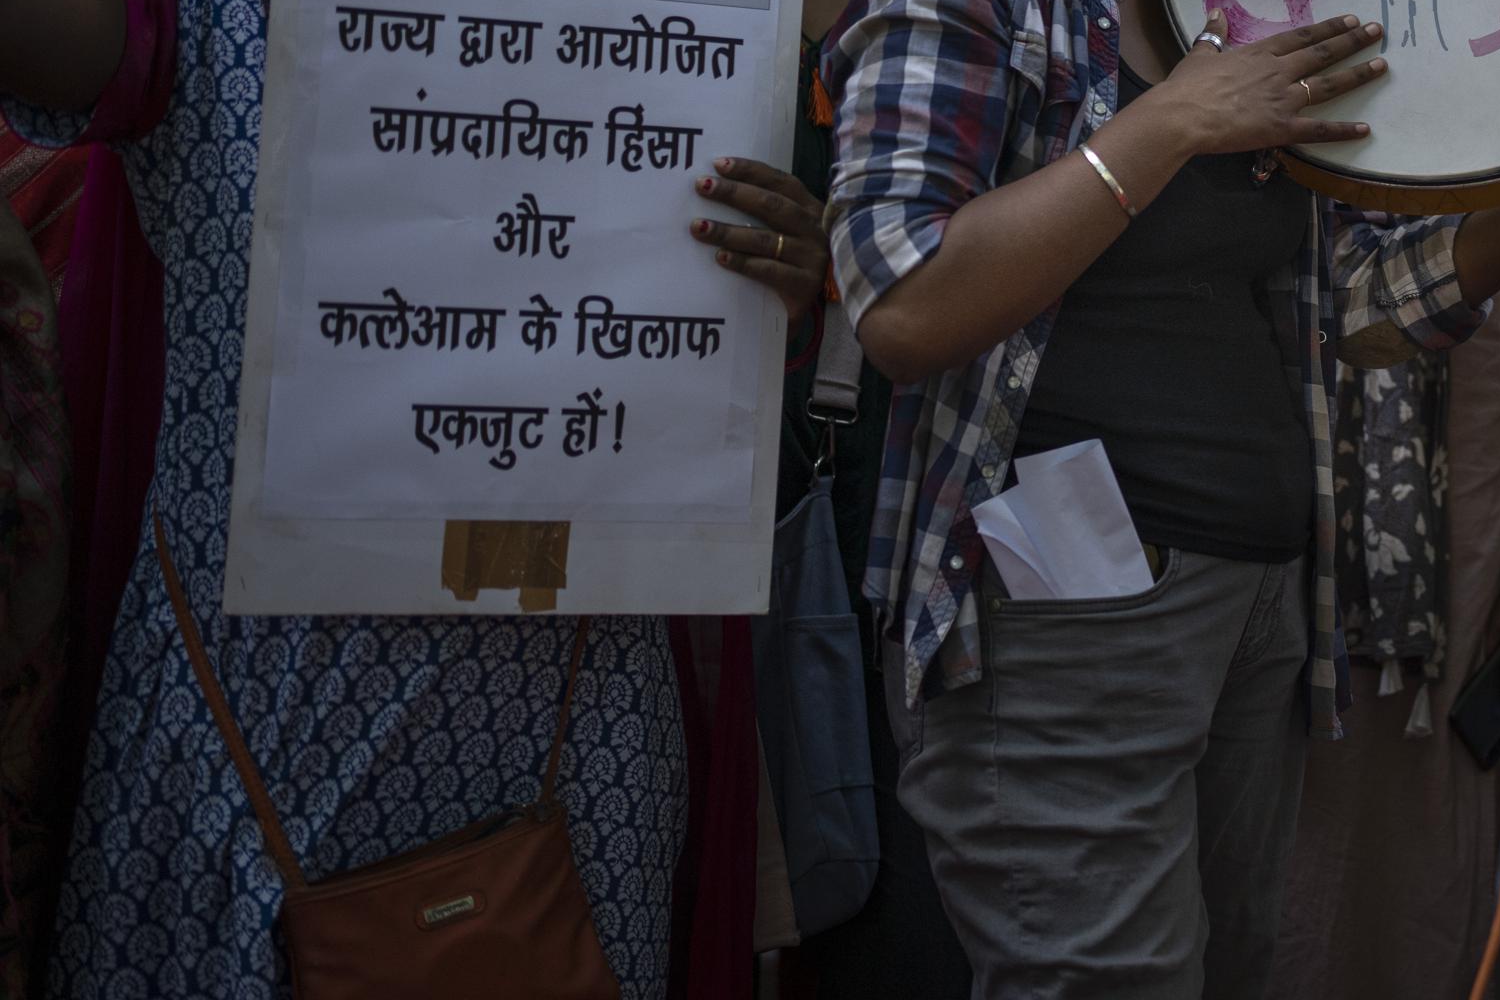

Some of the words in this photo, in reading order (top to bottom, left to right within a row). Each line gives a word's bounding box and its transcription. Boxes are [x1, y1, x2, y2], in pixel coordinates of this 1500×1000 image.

[336, 6, 445, 55] राज्य
[458, 16, 543, 67] द्वारा
[556, 15, 743, 80] आयोजित
[370, 88, 593, 163] सांप्रदायिक
[605, 104, 702, 172] हिंसा
[493, 193, 575, 259] और
[318, 288, 506, 353] कत्लेआम
[519, 294, 562, 355] के
[575, 295, 725, 360] खिलाफ
[412, 403, 549, 470] एकजुट
